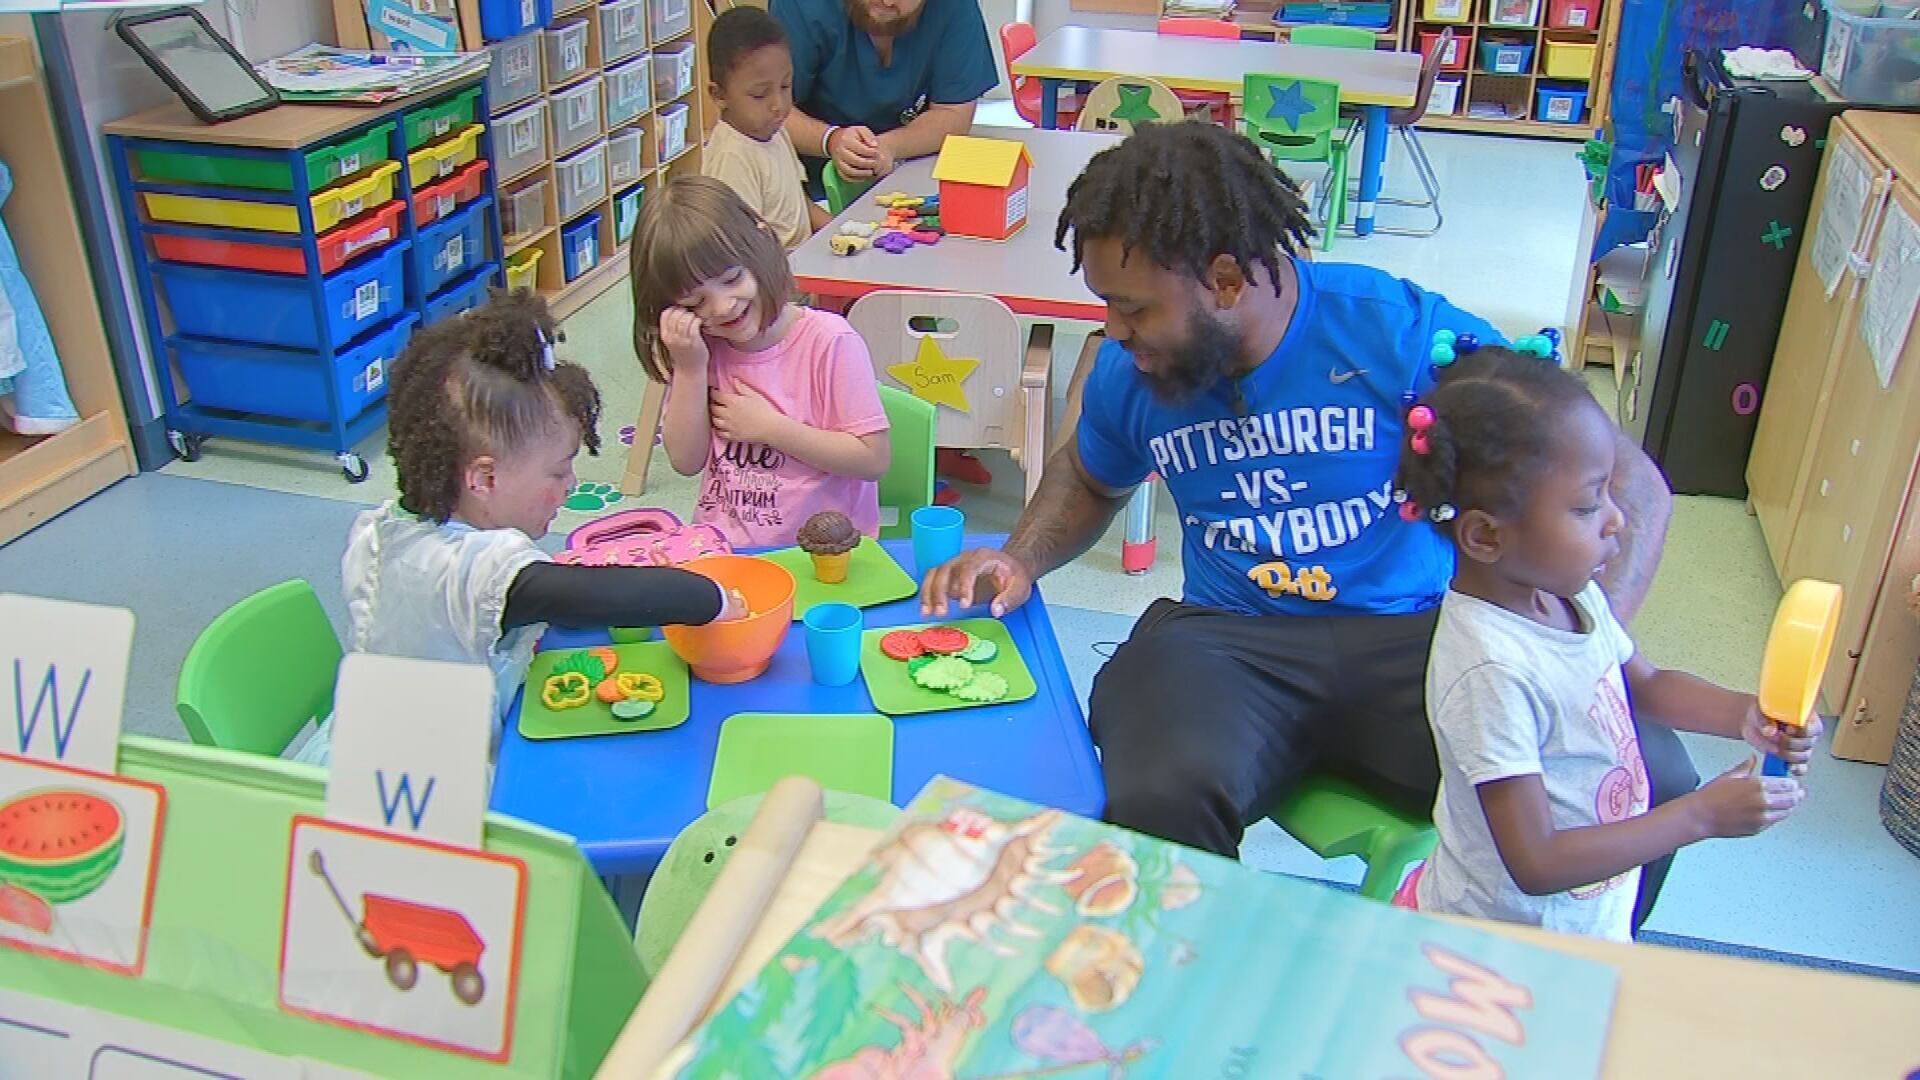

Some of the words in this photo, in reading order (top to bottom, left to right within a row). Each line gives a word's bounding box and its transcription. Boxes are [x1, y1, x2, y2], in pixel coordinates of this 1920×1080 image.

[914, 366, 956, 388] Sam
[1149, 406, 1376, 479] PITTSBURGH
[1247, 561, 1337, 601] Pitt
[13, 657, 93, 760] W
